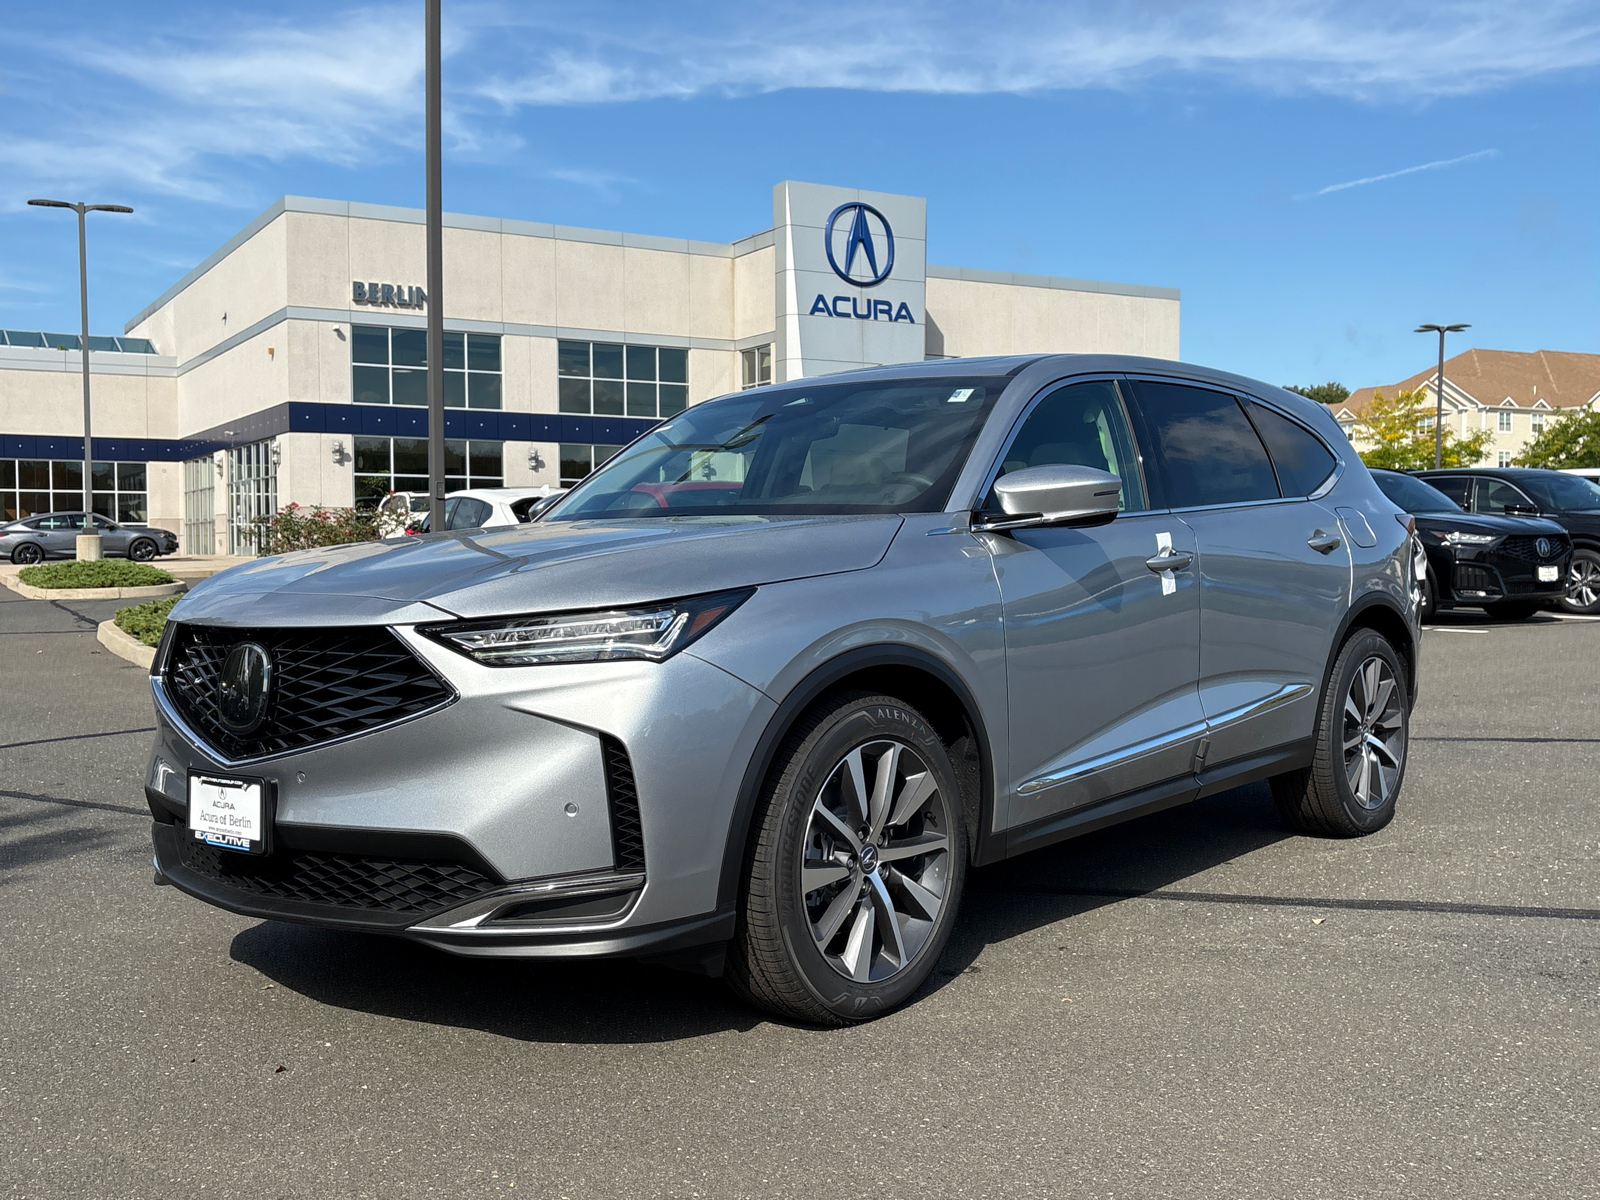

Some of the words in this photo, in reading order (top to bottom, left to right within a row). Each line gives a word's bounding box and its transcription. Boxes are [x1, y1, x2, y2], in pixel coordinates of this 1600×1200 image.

[352, 281, 428, 306] BERLIN
[809, 294, 915, 324] ACURA
[877, 708, 927, 735] ALENZA
[212, 800, 236, 811] ACURA
[200, 809, 219, 824] Acura
[219, 814, 227, 825] of
[229, 814, 252, 829] Berlin
[194, 831, 250, 848] EXECUTIVE
